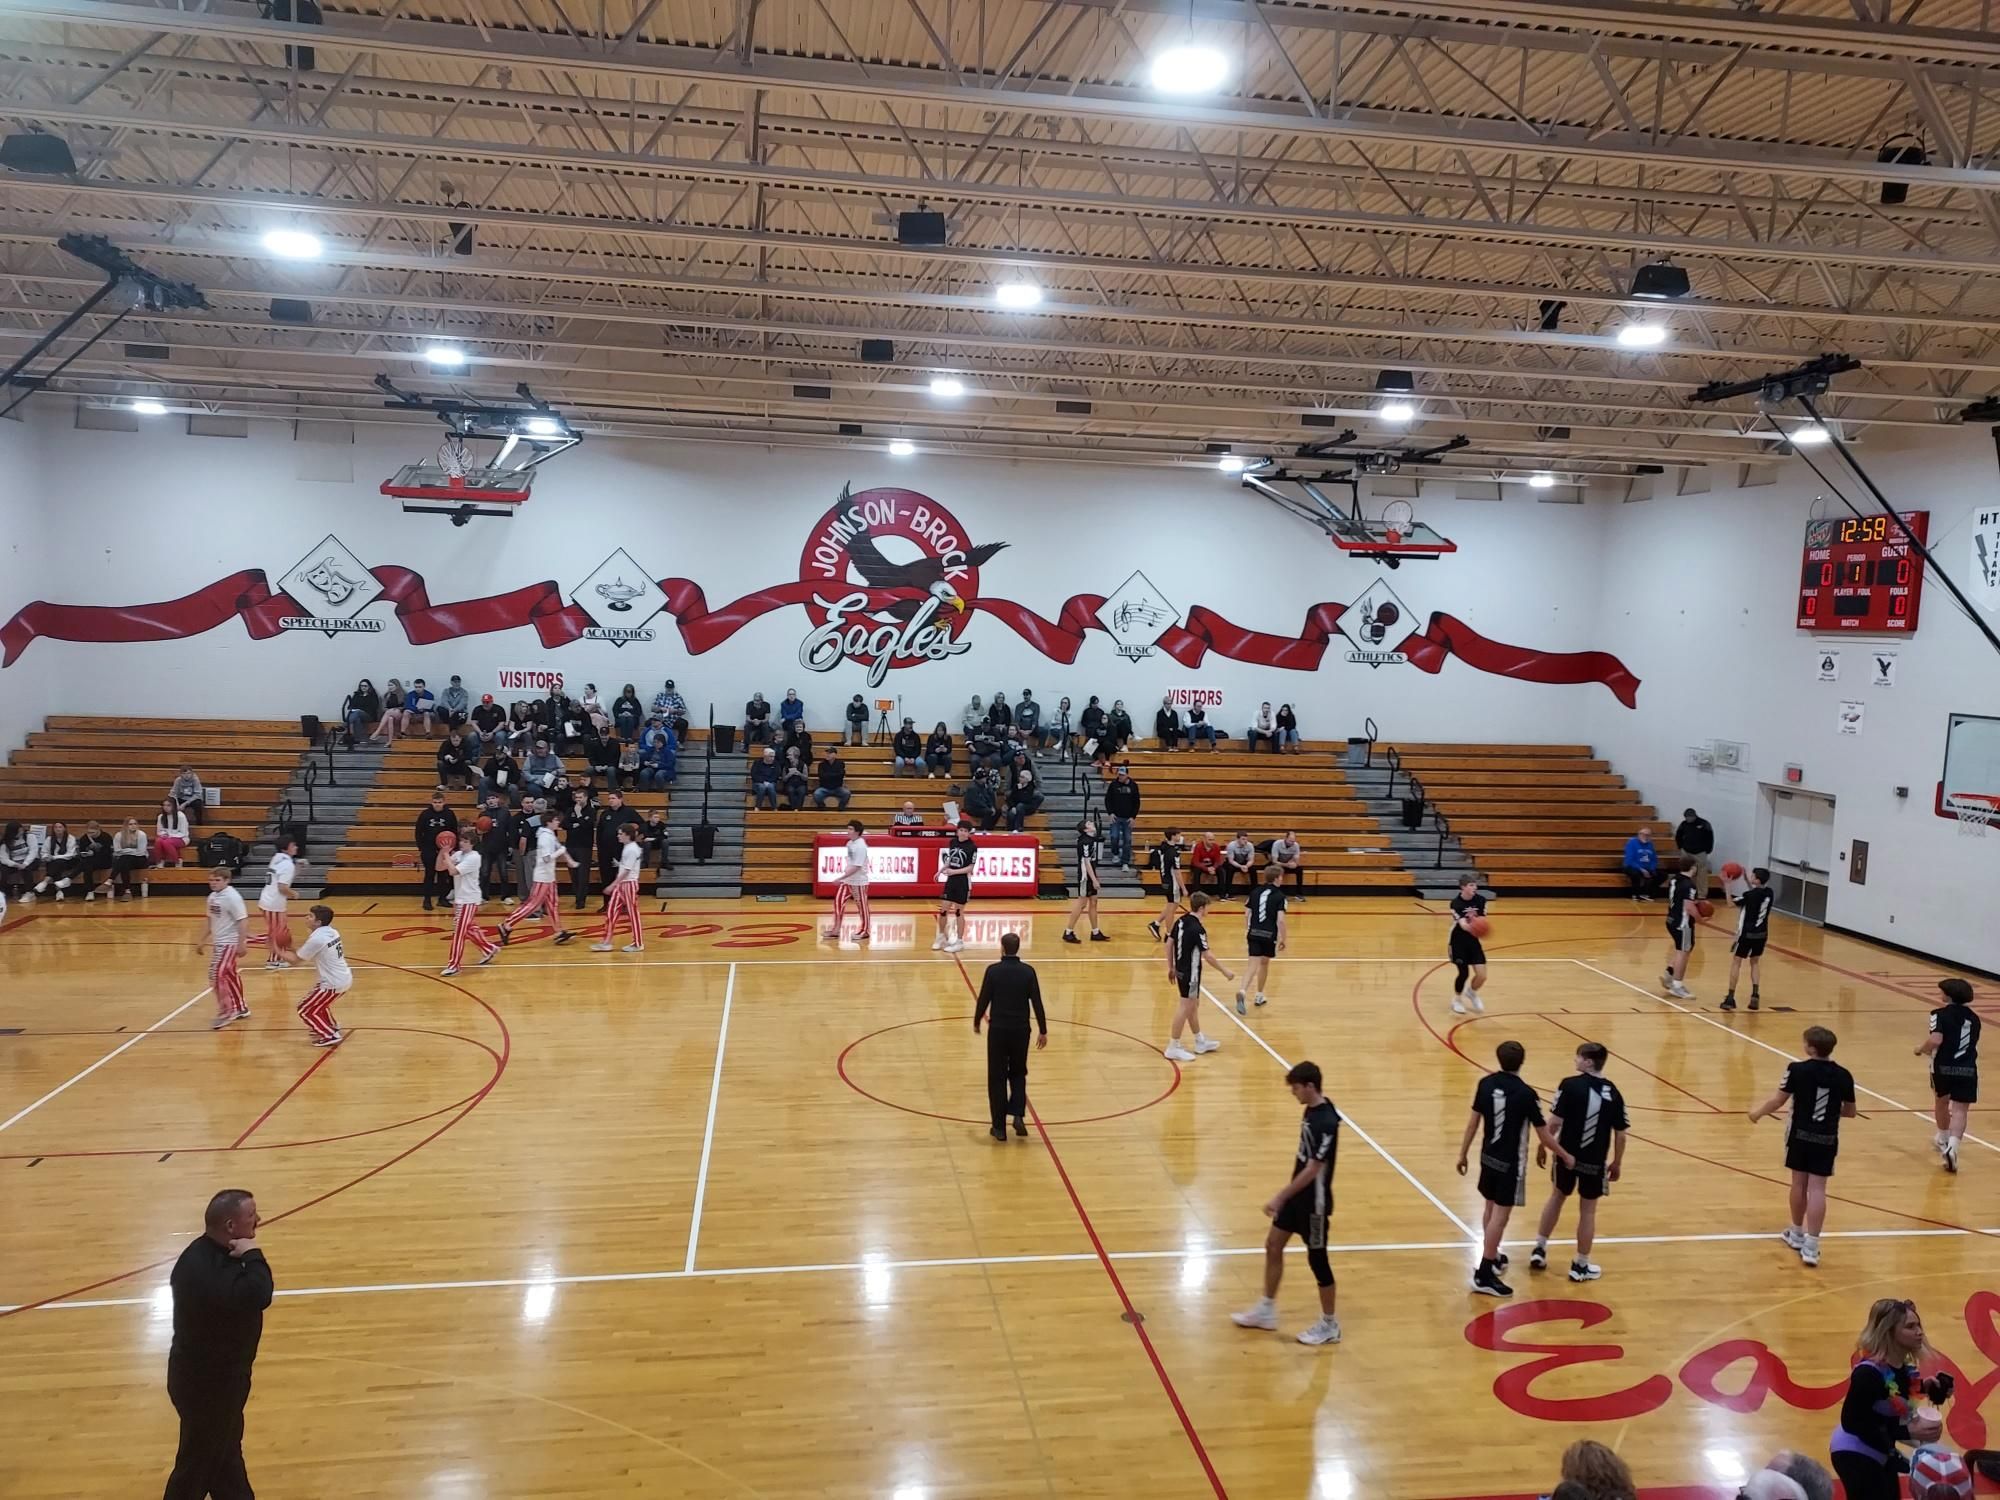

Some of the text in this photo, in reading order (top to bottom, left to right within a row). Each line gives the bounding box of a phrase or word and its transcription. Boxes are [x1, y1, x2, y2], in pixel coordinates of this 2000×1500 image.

[811, 498, 969, 581] JOHNSON-BROCK
[1809, 549, 1831, 561] HOME
[1821, 563, 1832, 586] 0
[1854, 565, 1860, 581] 1
[1897, 559, 1909, 584] 0
[1833, 588, 1871, 596] PLAYER FOUL
[1889, 587, 1908, 596] FOULS
[1806, 597, 1816, 615] 0
[1894, 596, 1906, 615] 0
[281, 617, 381, 630] SPEECH-DRAMA
[585, 628, 653, 639] ACADEMICS
[798, 592, 972, 689] Eagles
[1118, 646, 1153, 655] MUSIC
[1350, 652, 1403, 662] ATHLETICS
[499, 671, 564, 689] VISITORS
[1168, 689, 1223, 706] VISITORS
[969, 856, 1031, 878] AGLES
